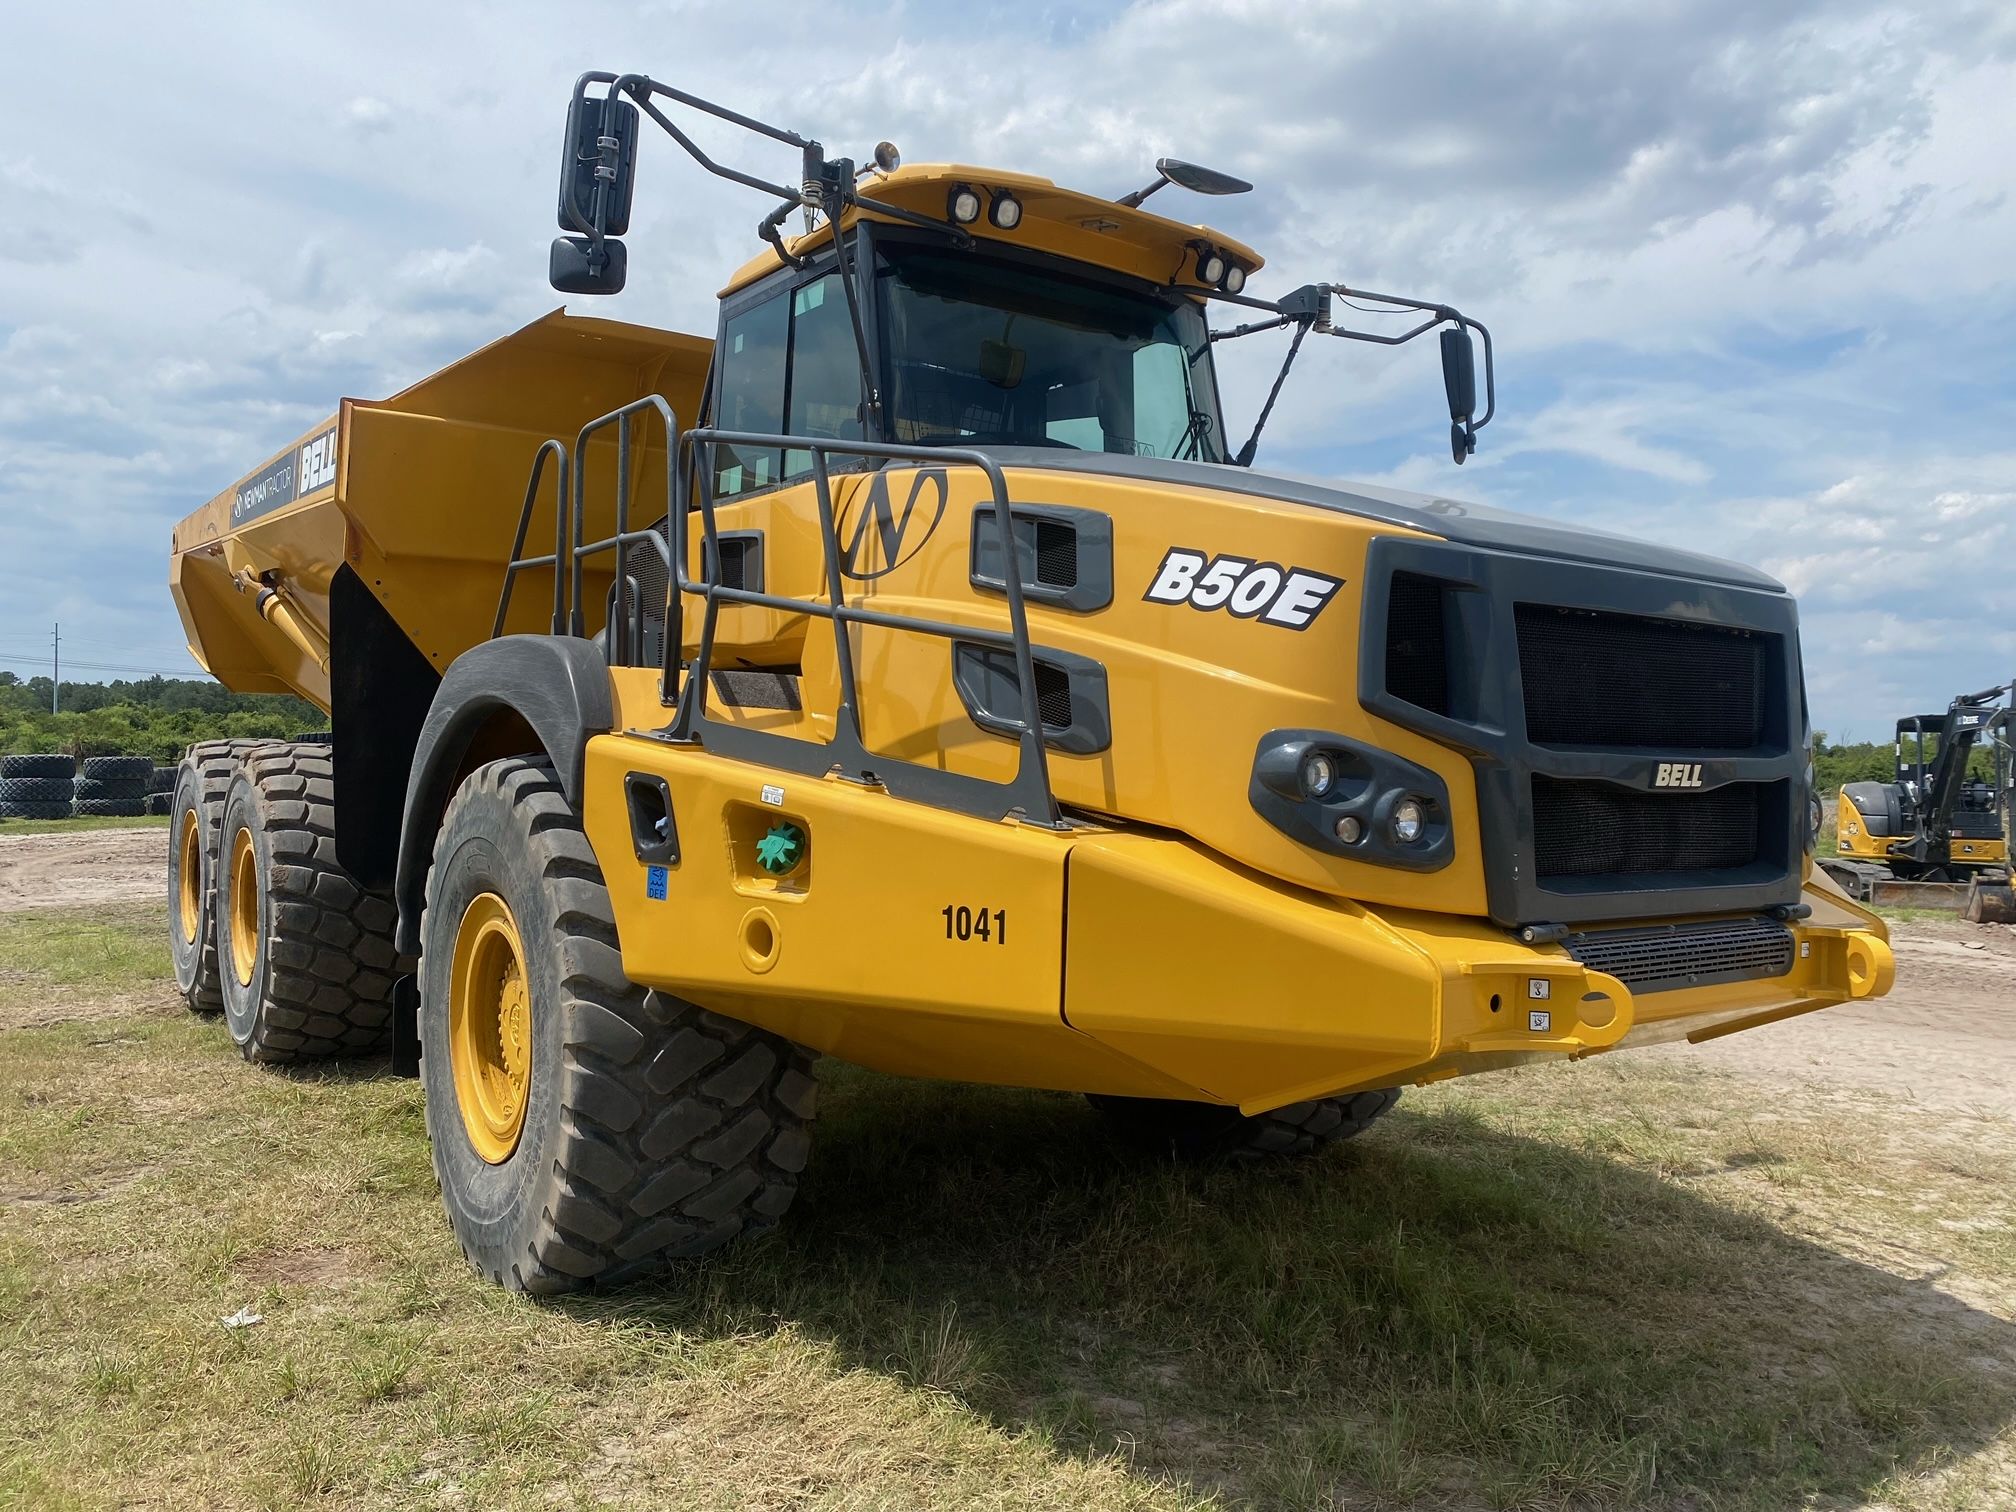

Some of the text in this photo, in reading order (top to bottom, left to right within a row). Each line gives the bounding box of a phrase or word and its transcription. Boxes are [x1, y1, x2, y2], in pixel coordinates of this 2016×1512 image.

[301, 431, 335, 494] BELL
[1145, 549, 1341, 629] B50E
[1655, 763, 1703, 787] BELL
[649, 888, 665, 899] DEF
[942, 904, 1006, 945] 1041
